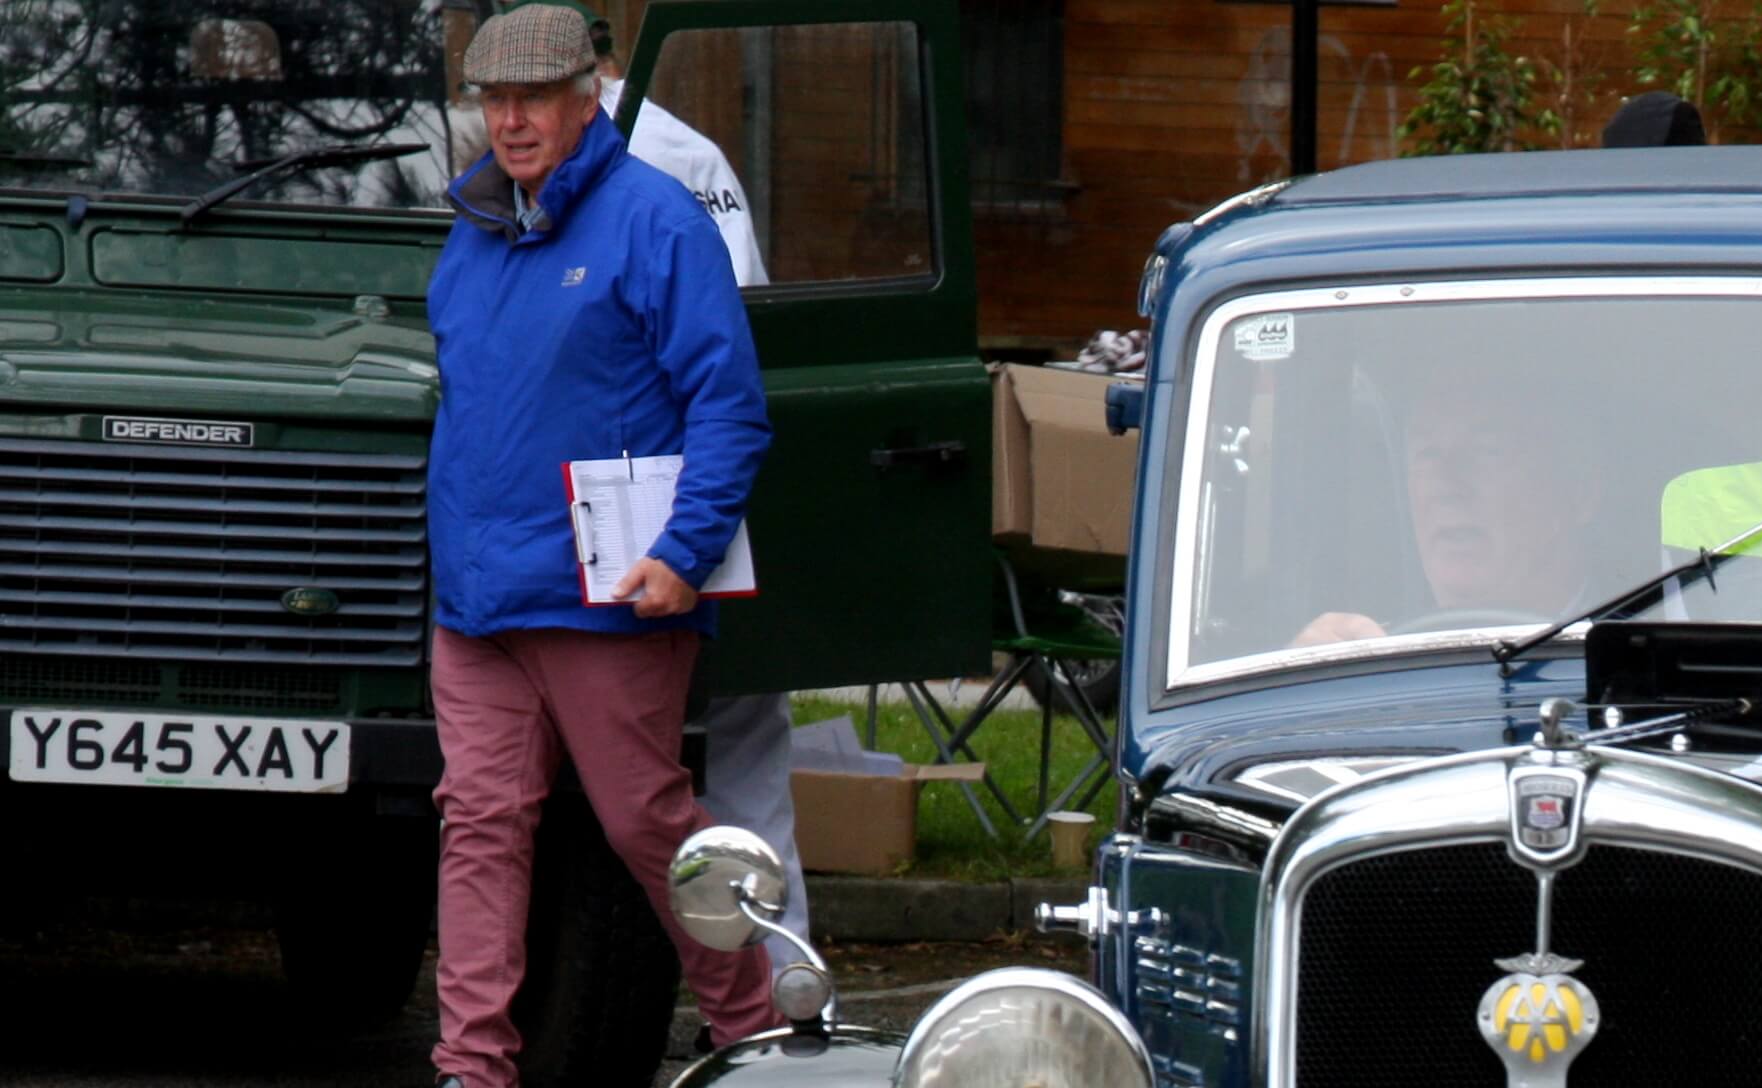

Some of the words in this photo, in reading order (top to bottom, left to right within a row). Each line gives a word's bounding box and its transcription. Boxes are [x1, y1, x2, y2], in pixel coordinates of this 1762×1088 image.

[112, 421, 242, 443] DEFENDER
[24, 717, 195, 775] Y645
[212, 724, 339, 780] XAY
